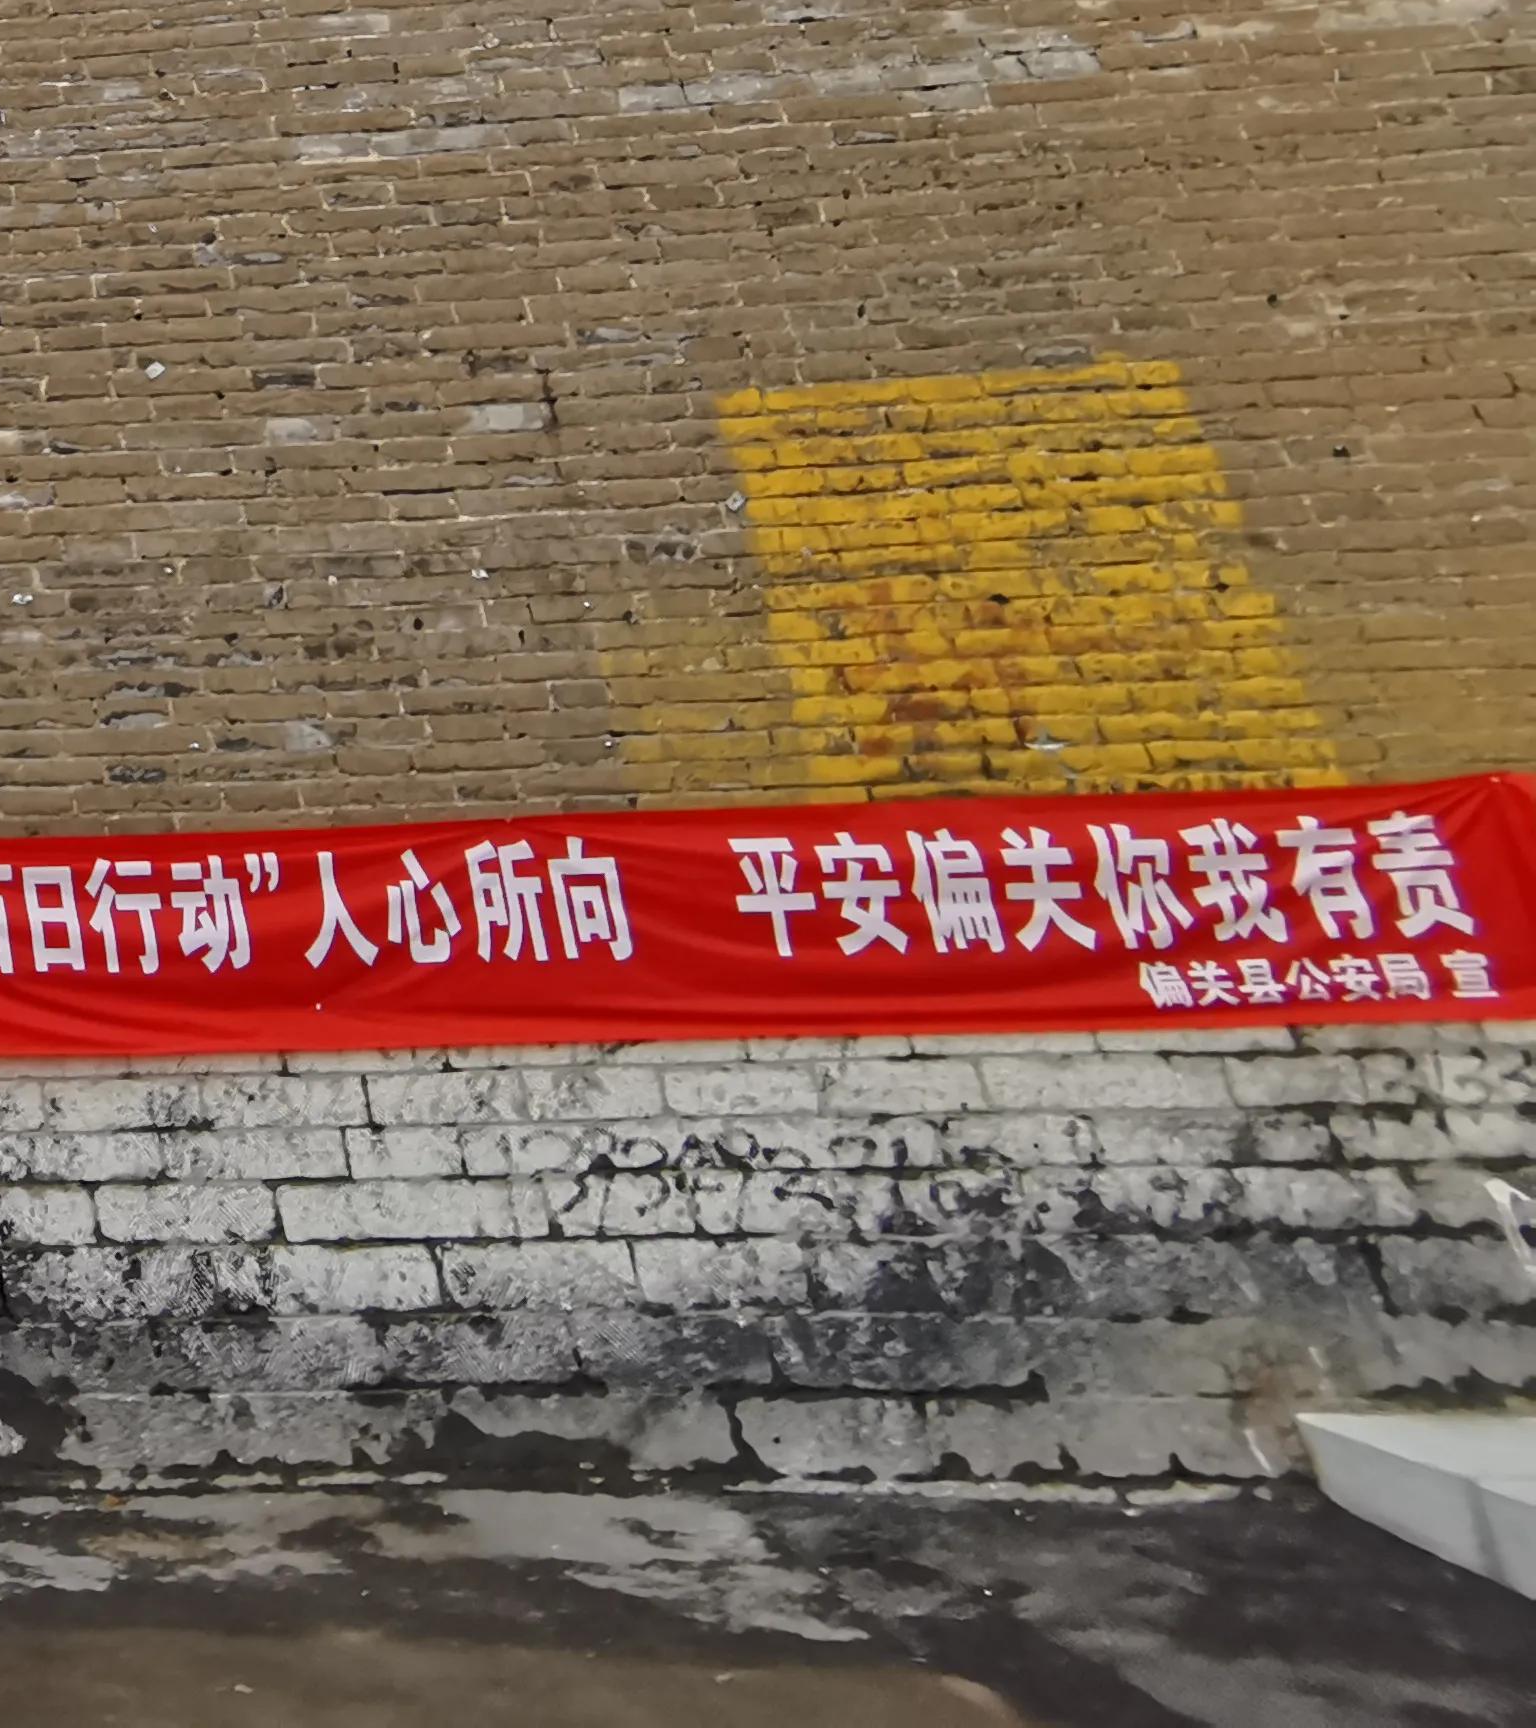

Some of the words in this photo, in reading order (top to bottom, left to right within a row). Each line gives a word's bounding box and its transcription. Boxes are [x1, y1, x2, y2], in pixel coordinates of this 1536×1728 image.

[729, 811, 1476, 959] 平安偏关你我有责
[1139, 953, 1432, 1009] 偏关县公安局
[1439, 949, 1500, 999] 宣
